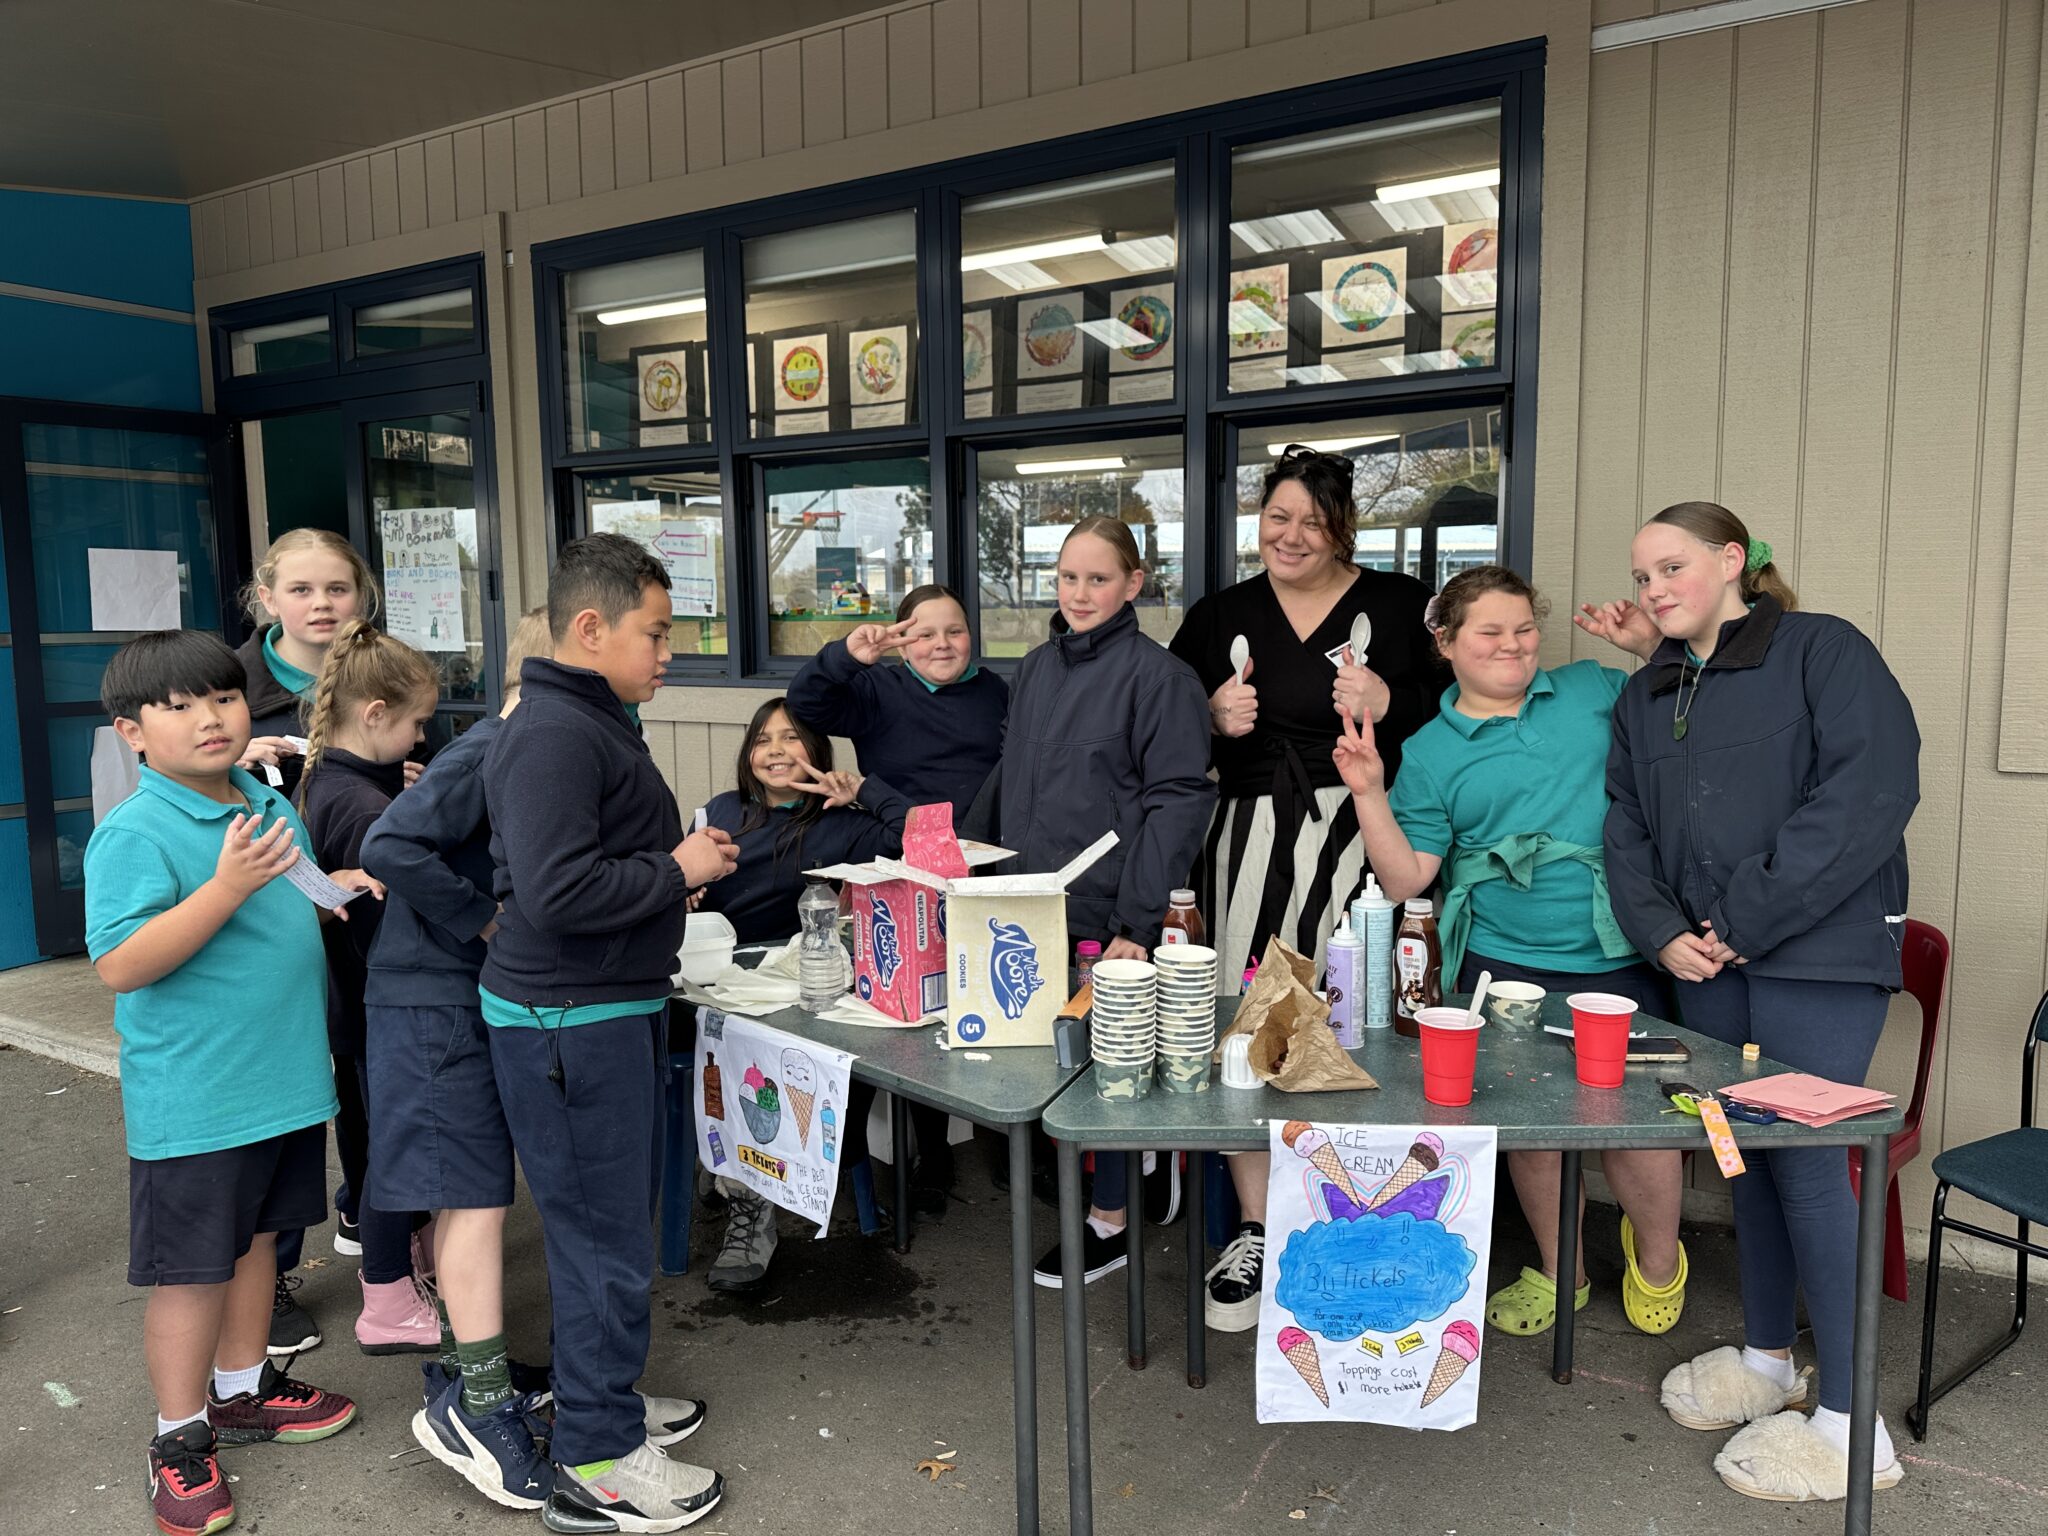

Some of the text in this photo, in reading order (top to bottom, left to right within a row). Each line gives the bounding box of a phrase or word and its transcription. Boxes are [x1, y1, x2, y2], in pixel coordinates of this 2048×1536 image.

[917, 894, 926, 947] NEAPOLITAN
[959, 953, 967, 989] COOKIES
[1021, 951, 1045, 991] Much
[861, 981, 870, 994] 5
[965, 1022, 981, 1034] 5
[1335, 1126, 1368, 1147] ICE
[796, 1162, 825, 1183] THE BEST
[1343, 1155, 1395, 1174] CREAM
[797, 1183, 811, 1196] ICE
[1341, 1261, 1407, 1289] Tickets
[1338, 1362, 1382, 1380] Toppings
[1360, 1383, 1391, 1396] more
